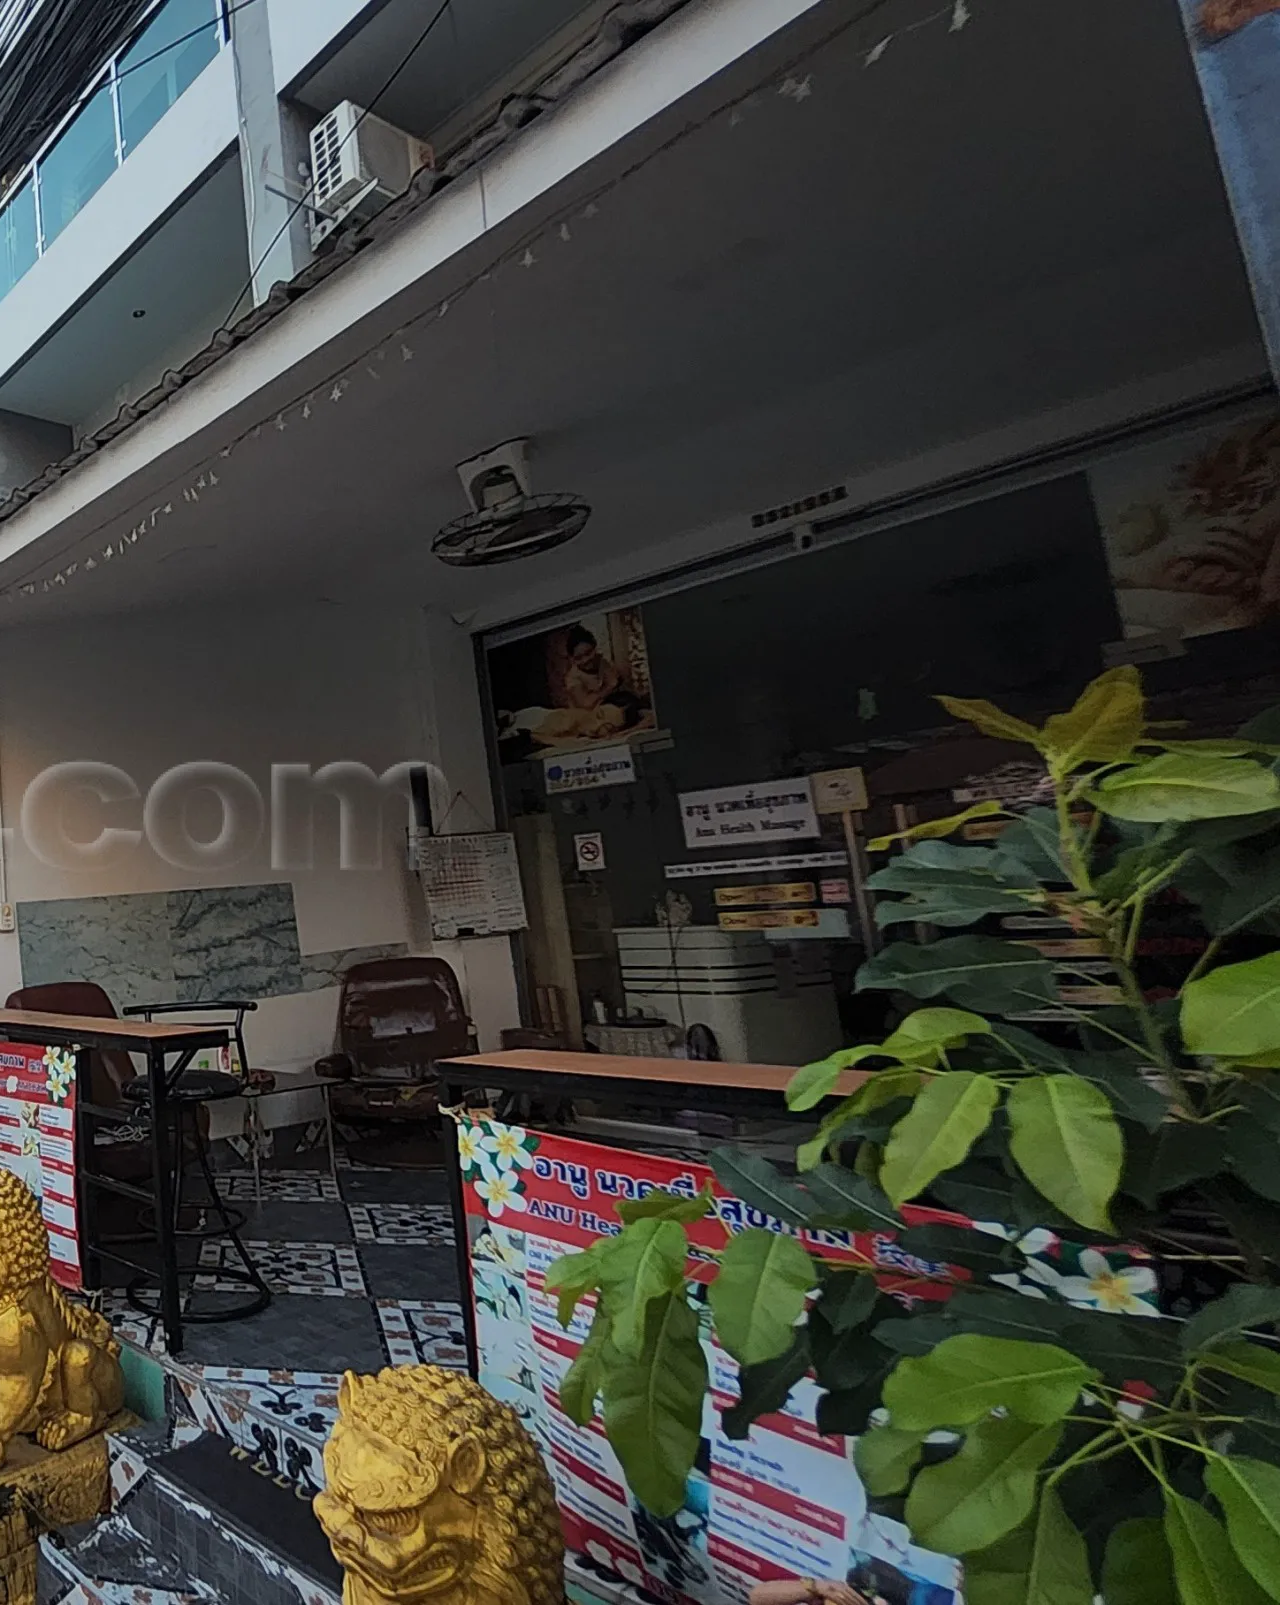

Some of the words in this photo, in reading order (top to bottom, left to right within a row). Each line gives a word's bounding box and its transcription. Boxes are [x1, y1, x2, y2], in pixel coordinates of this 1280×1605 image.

[533, 1156, 591, 1200] อานู
[528, 1199, 577, 1225] ANU
[579, 1211, 623, 1238] Hea
